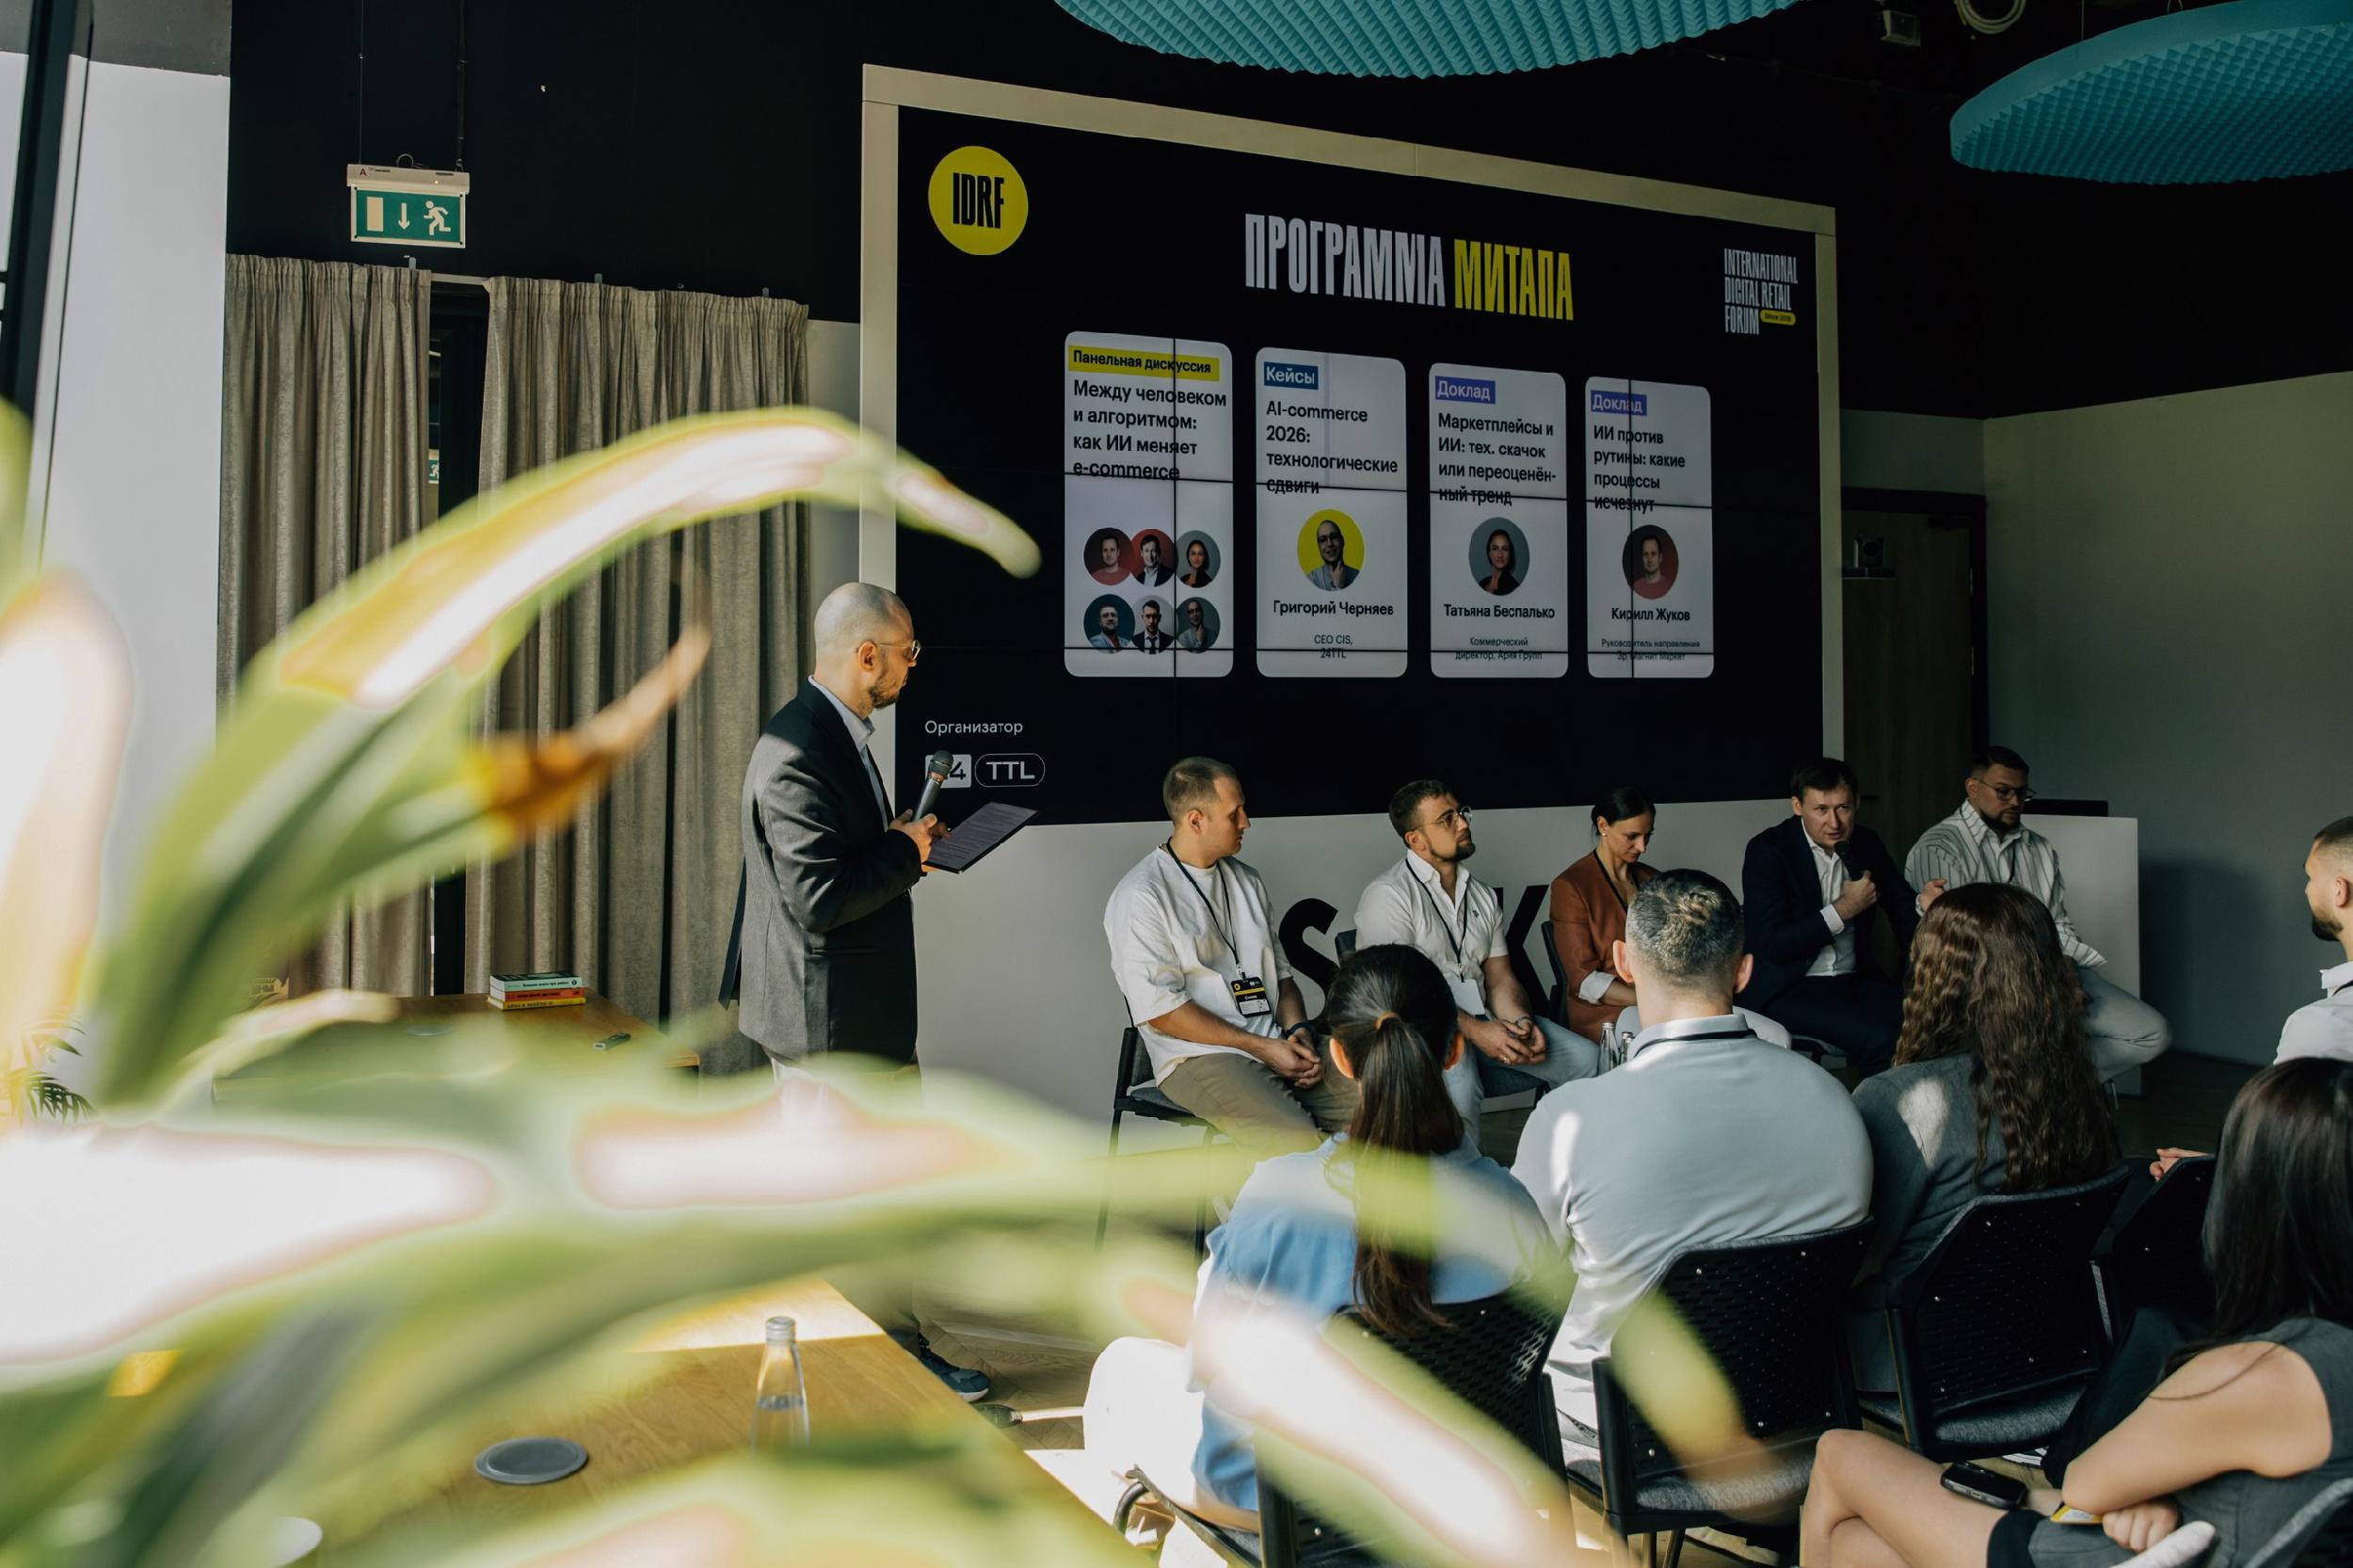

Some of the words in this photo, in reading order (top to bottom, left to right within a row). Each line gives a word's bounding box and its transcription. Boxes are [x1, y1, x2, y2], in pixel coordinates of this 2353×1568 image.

[952, 172, 1005, 229] IDRF
[1244, 213, 1446, 307] ПРОГРАММА
[1454, 238, 1574, 321] МИТАПА
[1724, 248, 1799, 284] INTERNATIONAL
[1724, 277, 1760, 307] DIGITAL
[1761, 281, 1792, 312] RETAIL
[1724, 305, 1760, 335] FORUM
[1073, 349, 1142, 368] Панельная
[1144, 358, 1211, 374] дискуссия
[1266, 365, 1315, 385] Кейсы
[1074, 379, 1131, 403] Между
[1136, 388, 1227, 407] человеком
[1437, 380, 1491, 401] Доклад
[1266, 400, 1369, 422] AI-commerce
[1593, 393, 1643, 413] Доклад
[1073, 408, 1083, 423] и
[1087, 409, 1197, 429] алгоритмом:
[1438, 412, 1543, 435] Маркетплейсы
[1546, 424, 1554, 436] и
[1266, 425, 1311, 443] 2026:
[1593, 424, 1614, 440] ИИ
[1618, 430, 1664, 444] против
[1073, 435, 1102, 451] как
[1106, 434, 1132, 452] ИИ
[1136, 440, 1197, 455] меняет
[1438, 437, 1465, 453] ИИ:
[1468, 441, 1496, 455] тех.
[1498, 444, 1546, 458] скачок
[1266, 453, 1399, 472] технологические
[1593, 450, 1646, 466] рутины:
[1649, 455, 1686, 468] какие
[1073, 461, 1180, 481] e-commerce
[1438, 463, 1465, 476] или
[1468, 465, 1556, 482] переоценён-
[1594, 473, 1660, 489] процессы
[1267, 478, 1320, 494] сдвиги
[1439, 485, 1467, 502] ный
[1470, 489, 1513, 506] тренд
[1273, 600, 1337, 616] Григорий
[1338, 601, 1394, 617] Черняев
[1444, 604, 1491, 617] Татьяна
[1494, 605, 1556, 618] Беспалько
[1611, 607, 1654, 622] Кирилл
[1657, 608, 1690, 623] Жуков
[1314, 634, 1334, 645] CEO
[1336, 634, 1353, 646] CIS,
[1469, 636, 1529, 648] Коммерческий
[1321, 648, 1347, 659] 24TTL
[924, 720, 1024, 737] Организатор
[986, 760, 1035, 780] TTL
